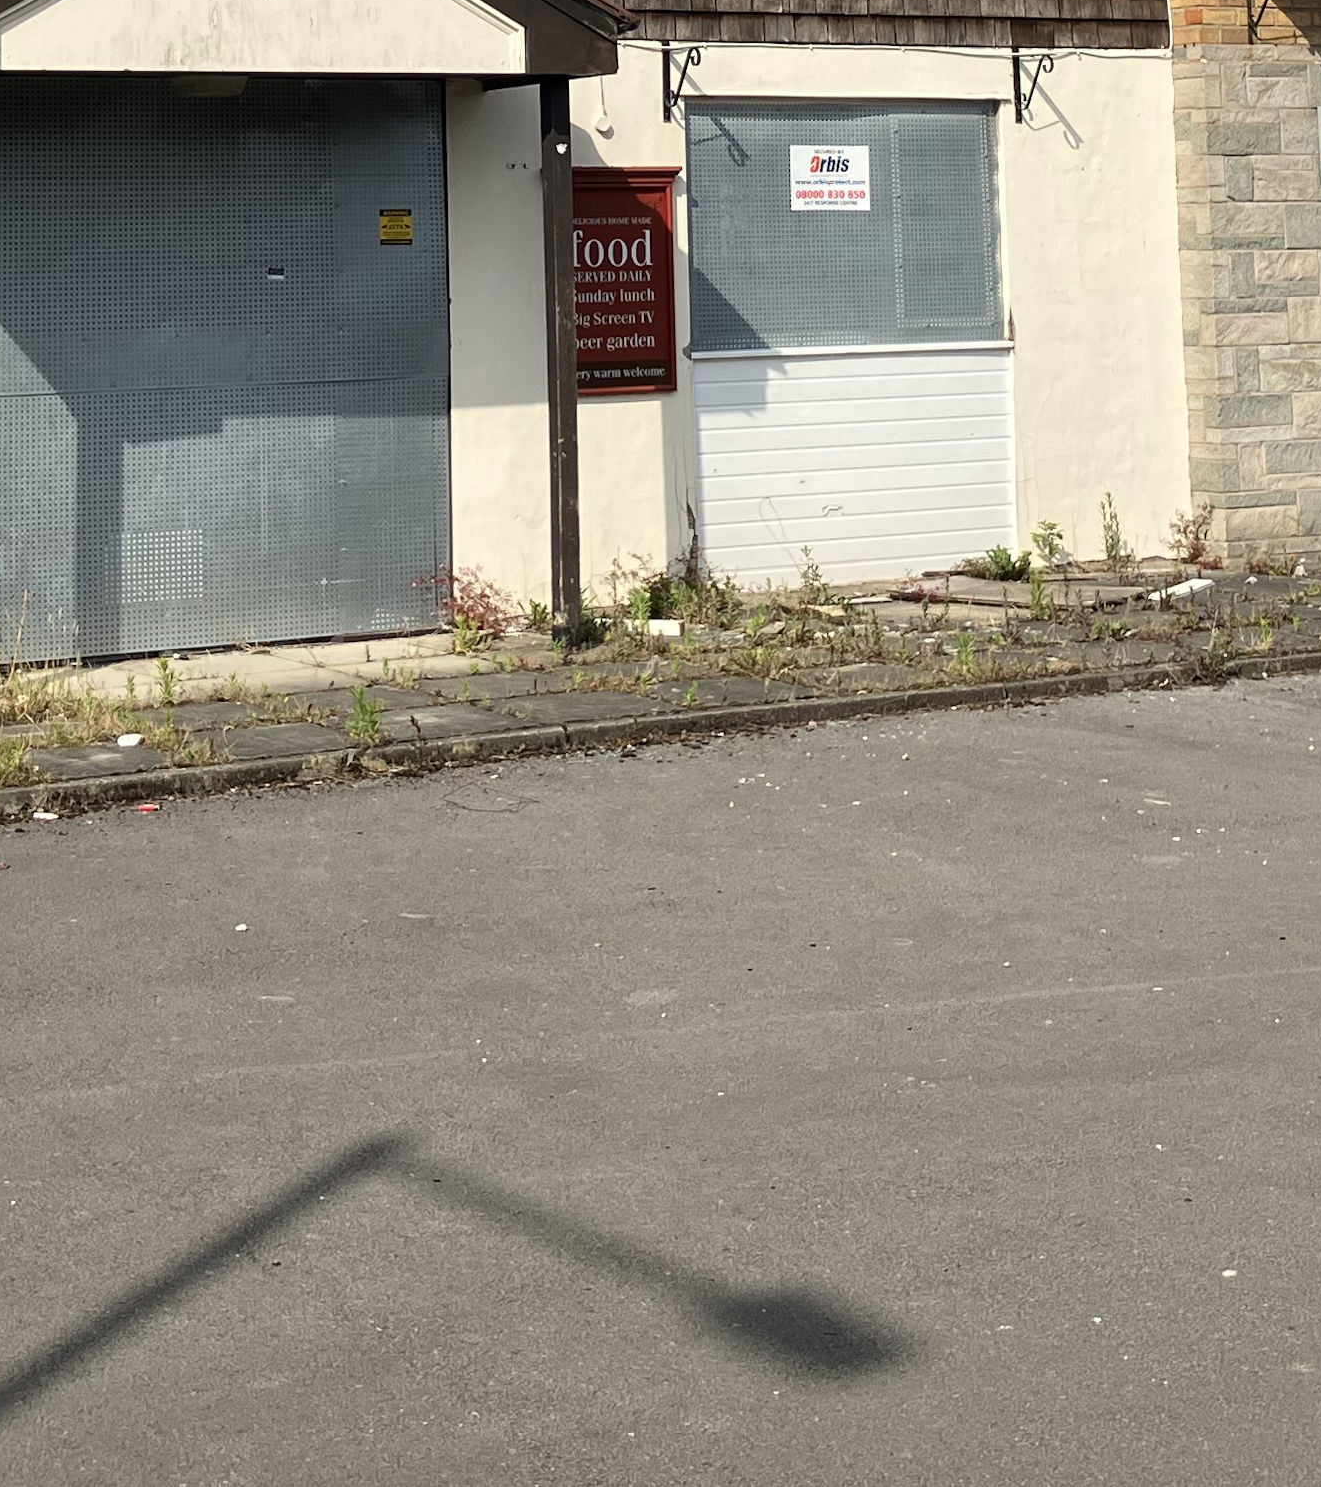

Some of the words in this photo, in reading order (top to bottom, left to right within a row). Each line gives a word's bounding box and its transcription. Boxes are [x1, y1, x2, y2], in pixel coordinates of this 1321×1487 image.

[810, 156, 849, 172] Orbis
[796, 190, 825, 200] 08000
[828, 190, 846, 200] 830
[848, 190, 865, 200] 850
[608, 217, 629, 225] HOME
[631, 216, 652, 224] MADE
[573, 229, 653, 268] food
[619, 269, 653, 282] DAILY
[620, 288, 655, 302] lunch
[593, 312, 636, 326] Screen
[638, 311, 655, 324] TV
[606, 333, 656, 352] garden
[593, 369, 621, 380] warm
[623, 366, 666, 377] welcome
